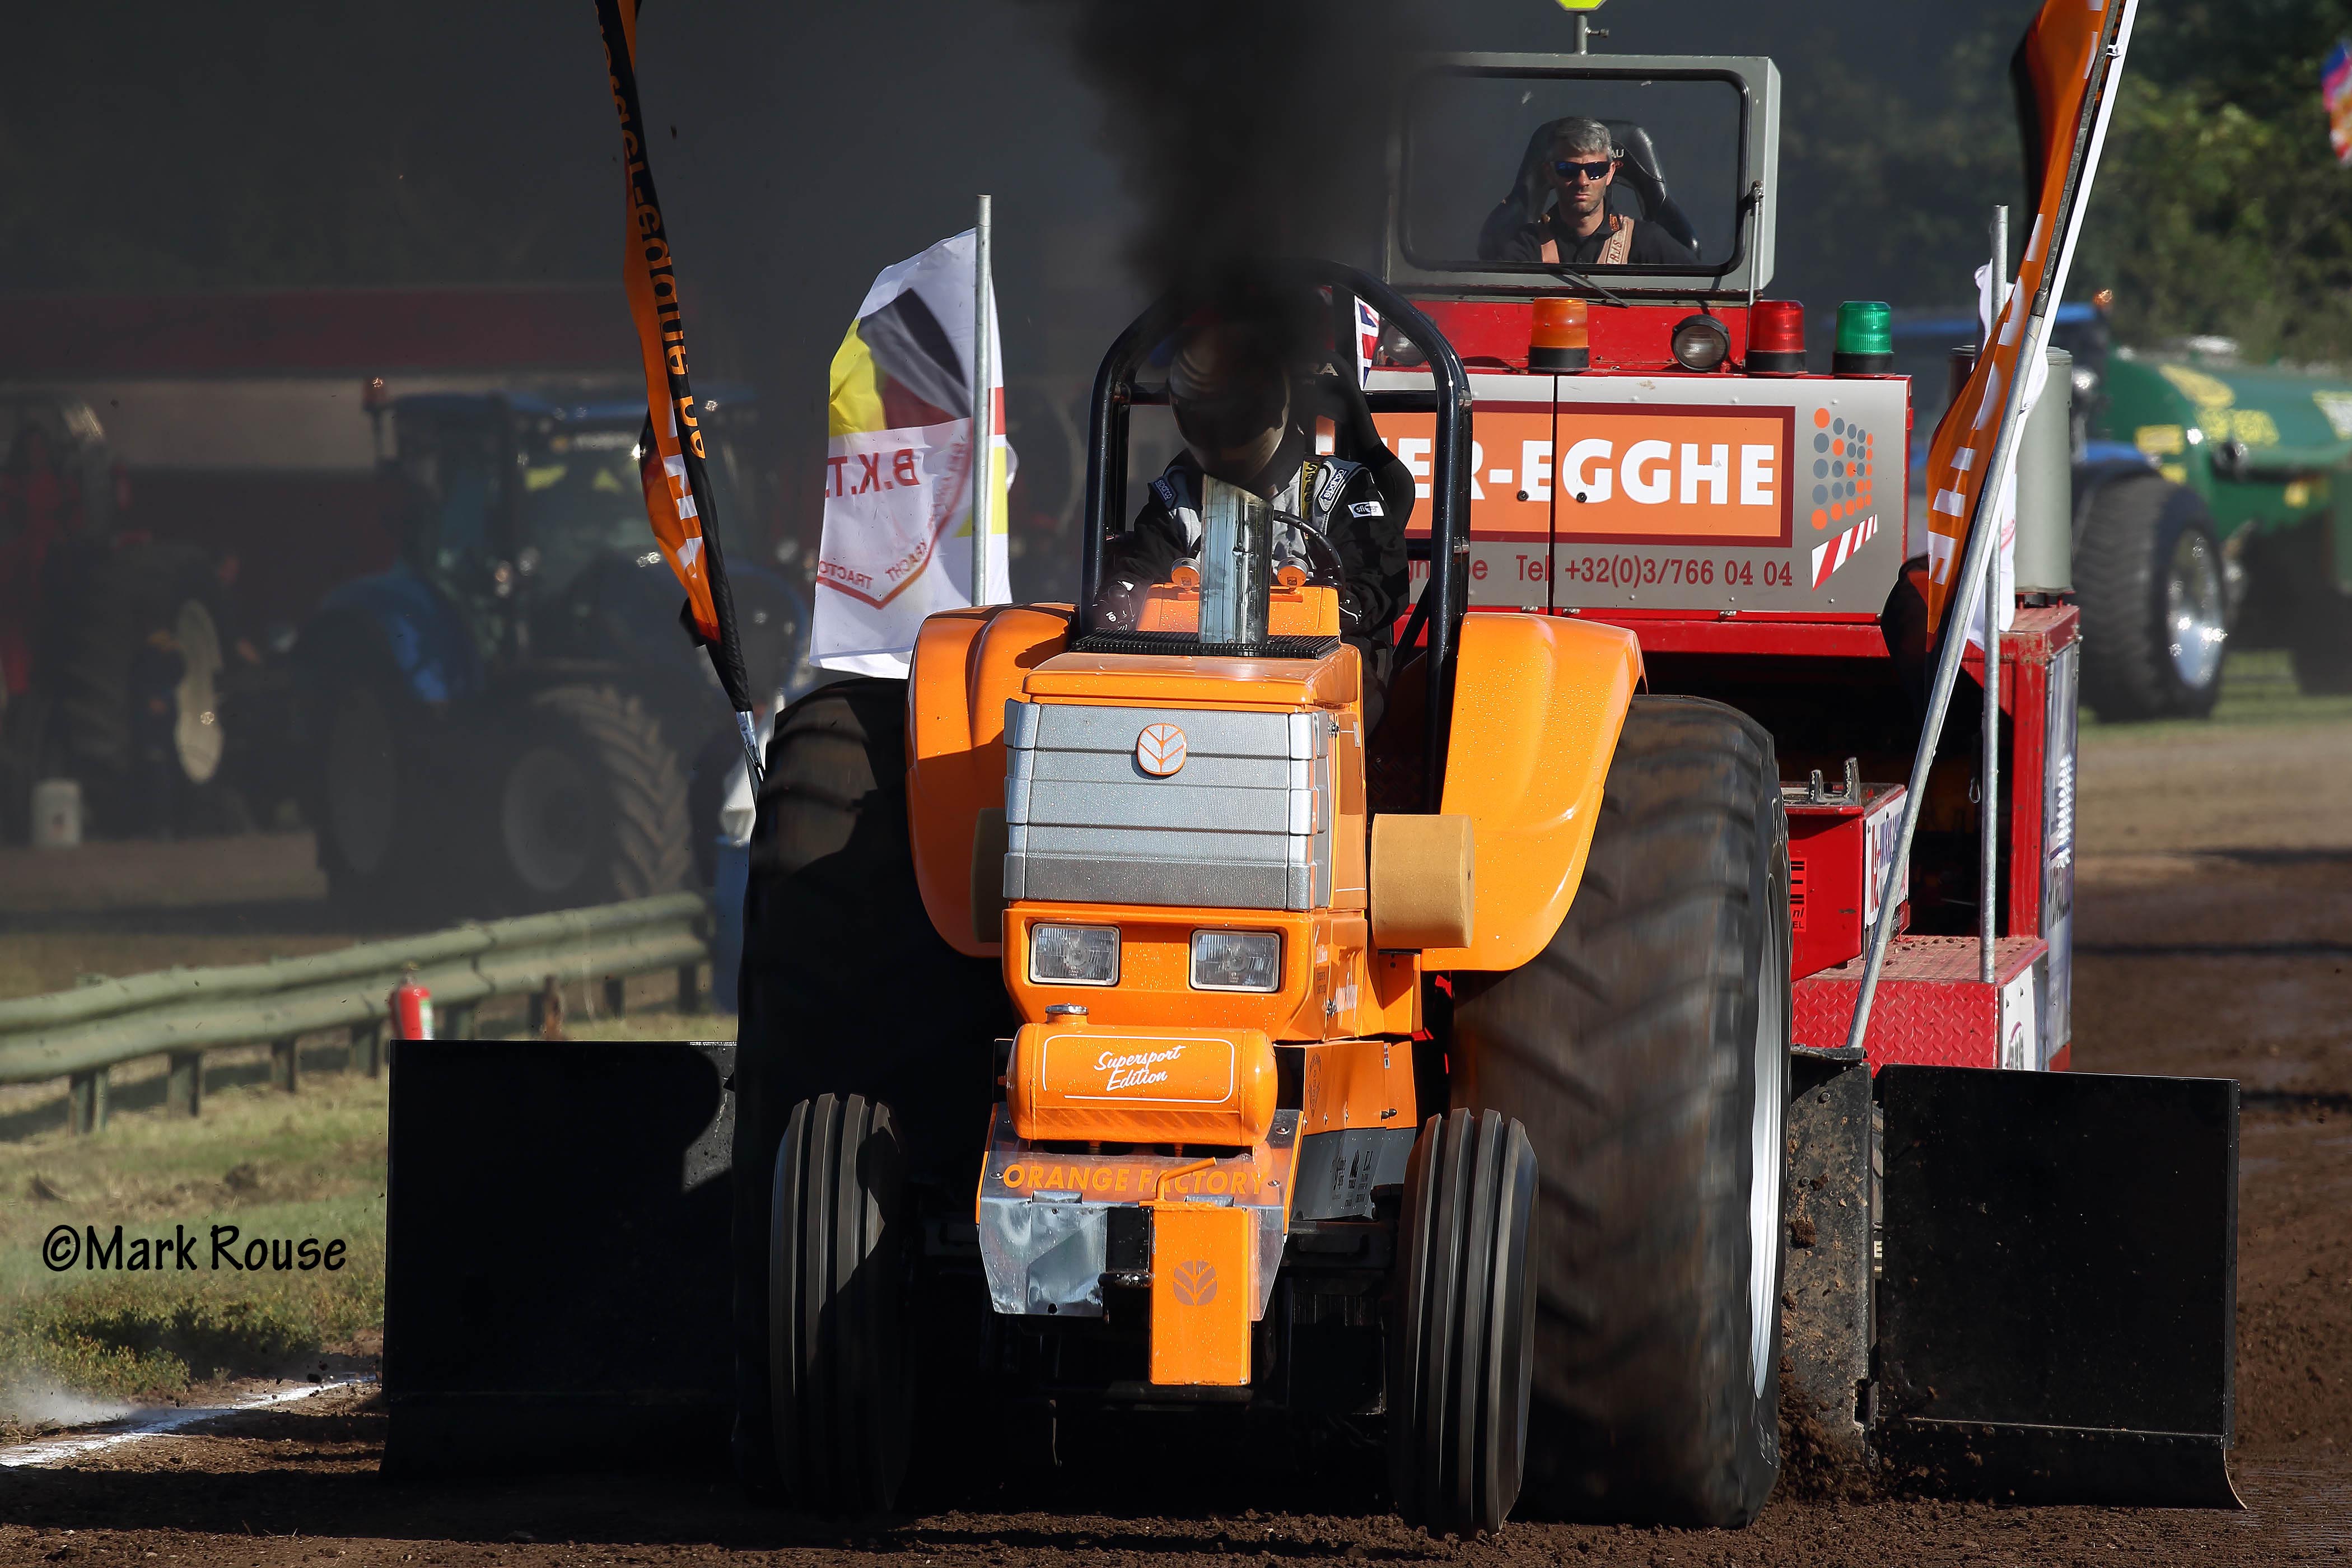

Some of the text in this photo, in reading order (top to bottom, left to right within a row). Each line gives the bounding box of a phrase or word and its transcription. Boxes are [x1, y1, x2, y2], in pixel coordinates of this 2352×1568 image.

[1380, 436, 1774, 506] E-EGGHE
[1565, 554, 1714, 589] +32(0)3/766
[1725, 559, 1753, 586] 04
[1764, 560, 1792, 586] 04
[1094, 1045, 1186, 1071] Supersport
[1106, 1068, 1168, 1091] Edition
[1003, 1164, 1130, 1192] ORANGE
